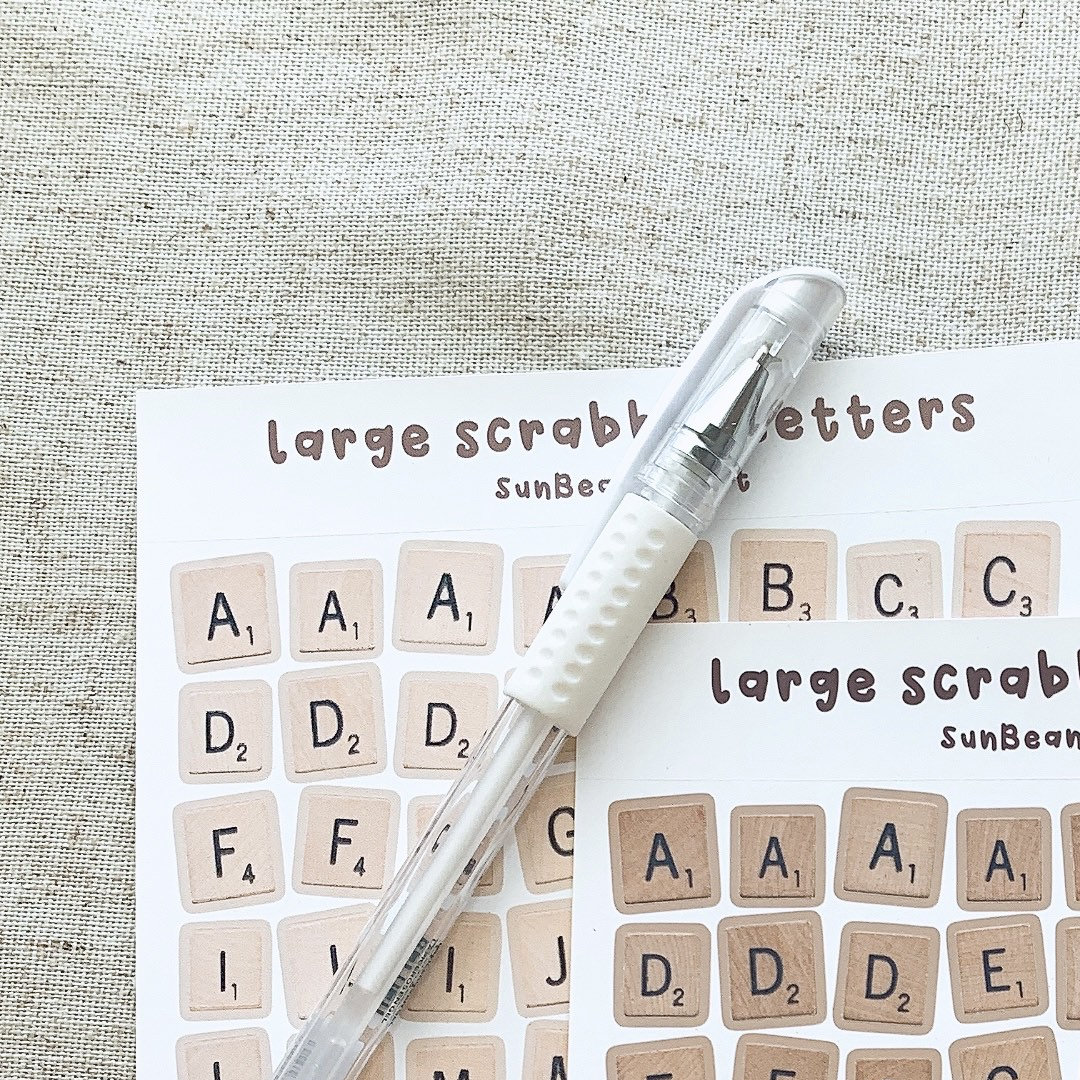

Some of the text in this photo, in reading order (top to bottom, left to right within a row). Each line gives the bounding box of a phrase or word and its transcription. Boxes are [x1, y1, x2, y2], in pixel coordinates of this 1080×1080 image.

[268, 393, 976, 468] large scrab etters
[712, 658, 875, 712] large
